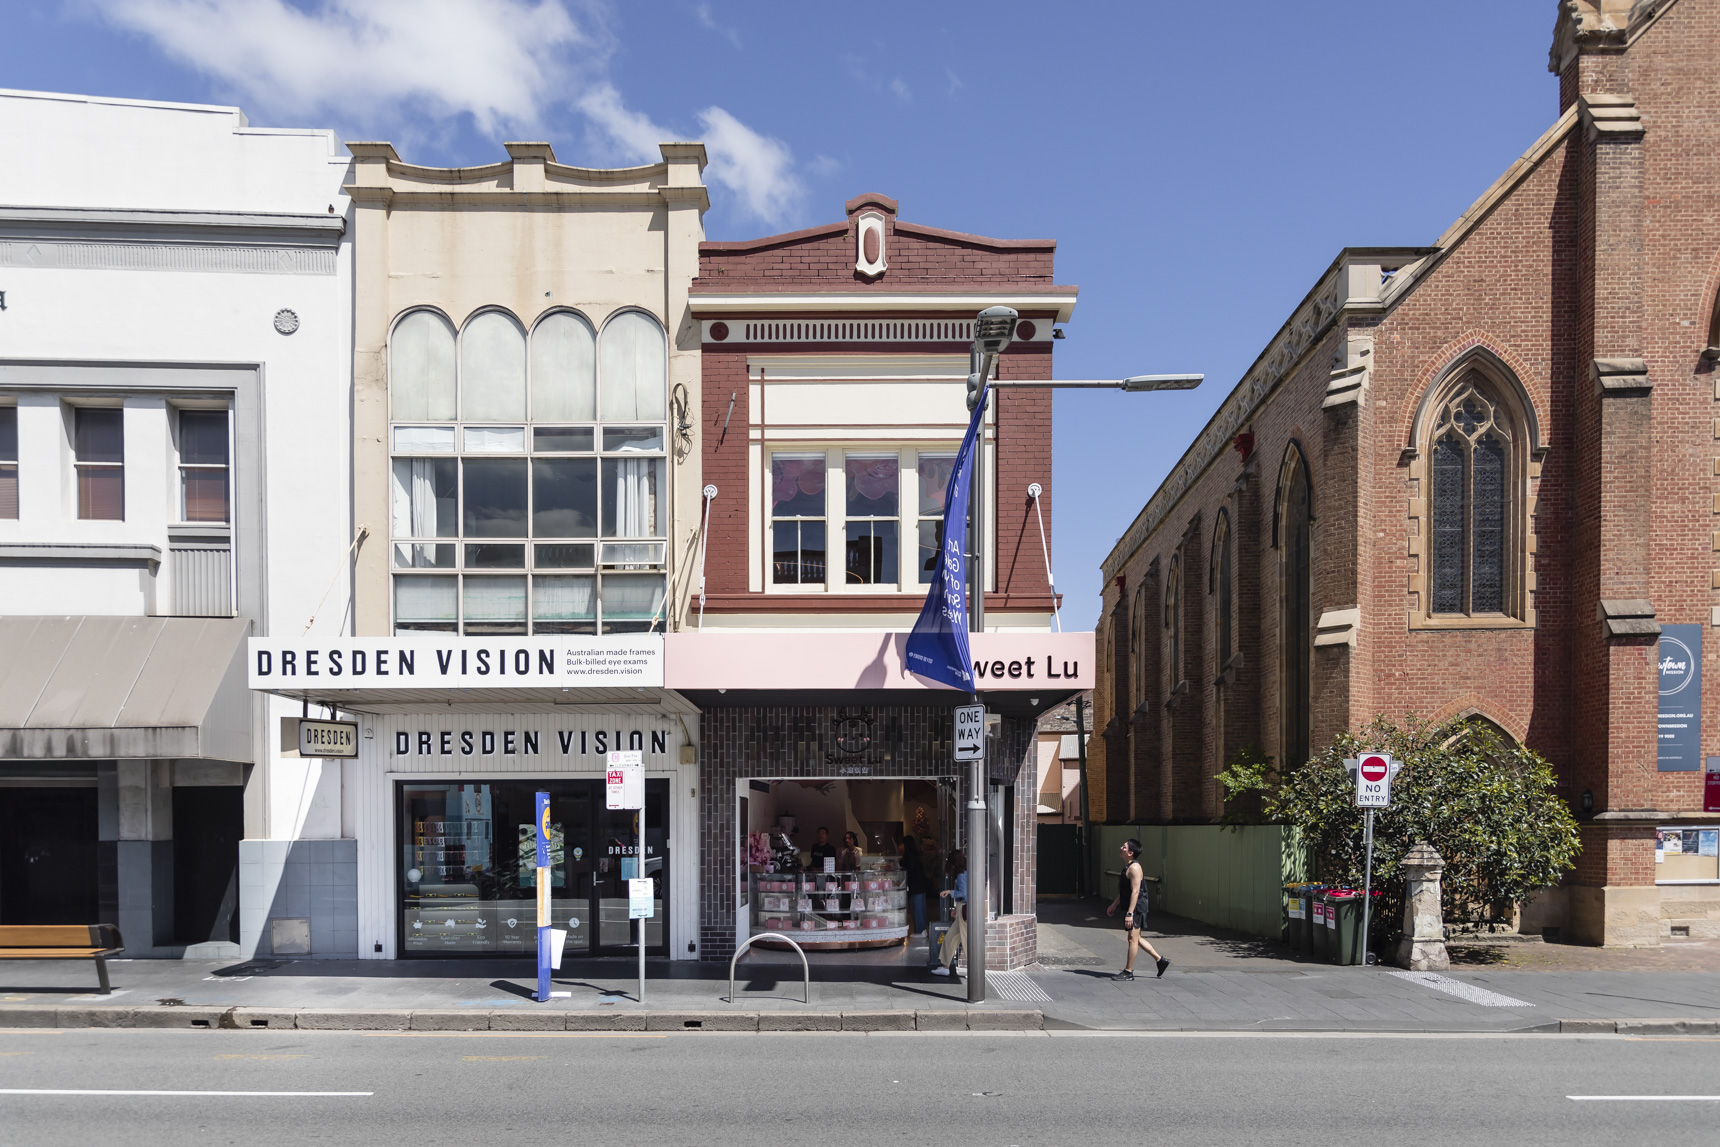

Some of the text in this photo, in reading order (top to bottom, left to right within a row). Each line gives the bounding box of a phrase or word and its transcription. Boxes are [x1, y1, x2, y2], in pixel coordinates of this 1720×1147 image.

[629, 648, 656, 656] frames
[257, 649, 554, 676] DRESDEN VISION
[566, 658, 607, 666] Bulk-billed
[608, 659, 622, 667] eye
[973, 656, 1035, 679] weet
[1047, 655, 1079, 679] Lu
[1658, 656, 1687, 675] wtown
[566, 667, 643, 675] www.dresden.vision
[959, 711, 980, 724] ONE
[306, 728, 351, 746] DRESDEN
[957, 727, 981, 741] WAY
[396, 730, 666, 755] DRESDEN VISION
[1365, 784, 1381, 793] NO
[608, 846, 653, 855] DRESDN
